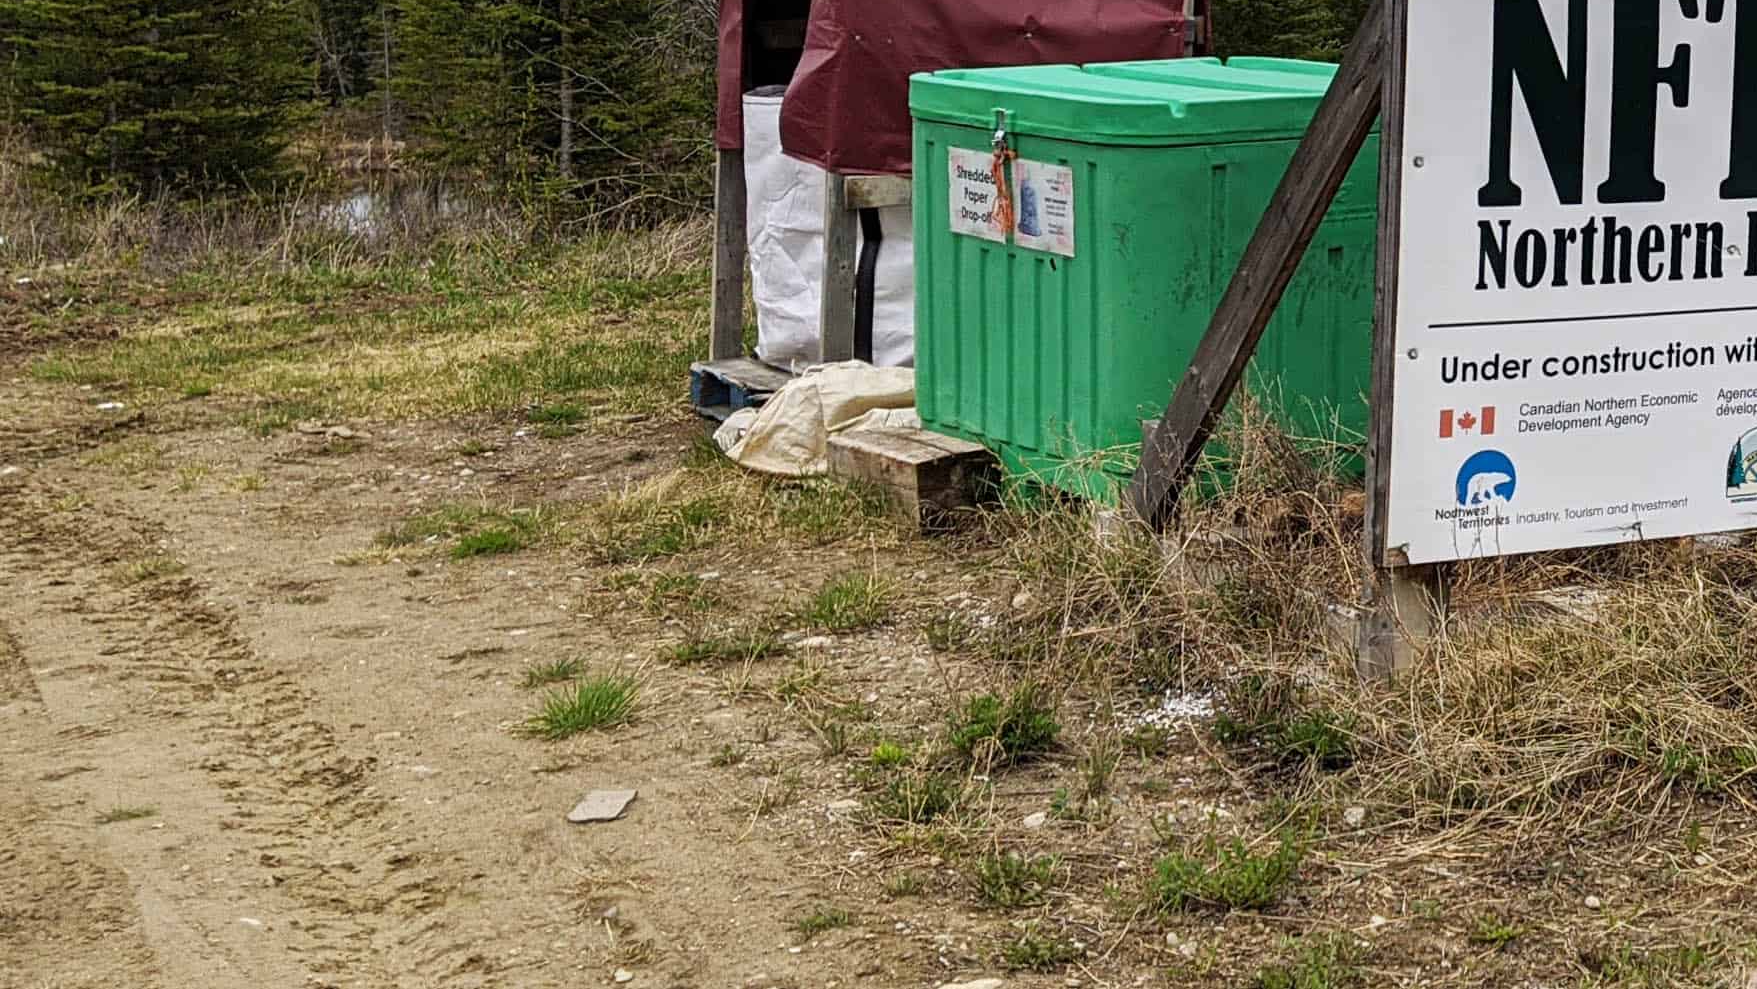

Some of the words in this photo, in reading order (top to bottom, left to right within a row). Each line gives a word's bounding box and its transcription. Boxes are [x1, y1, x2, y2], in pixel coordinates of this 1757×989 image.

[964, 187, 988, 205] Paper
[1475, 215, 1724, 290] Northern
[1441, 353, 1532, 384] Under
[1542, 341, 1714, 377] construction
[1519, 400, 1581, 417] Canadian
[1584, 396, 1637, 412] Northern
[1641, 391, 1699, 407] Economic
[1518, 415, 1602, 433] Development
[1605, 412, 1651, 428] Agency
[1564, 507, 1604, 520] Tourism
[1607, 502, 1629, 516] and
[1631, 497, 1688, 513] Investment
